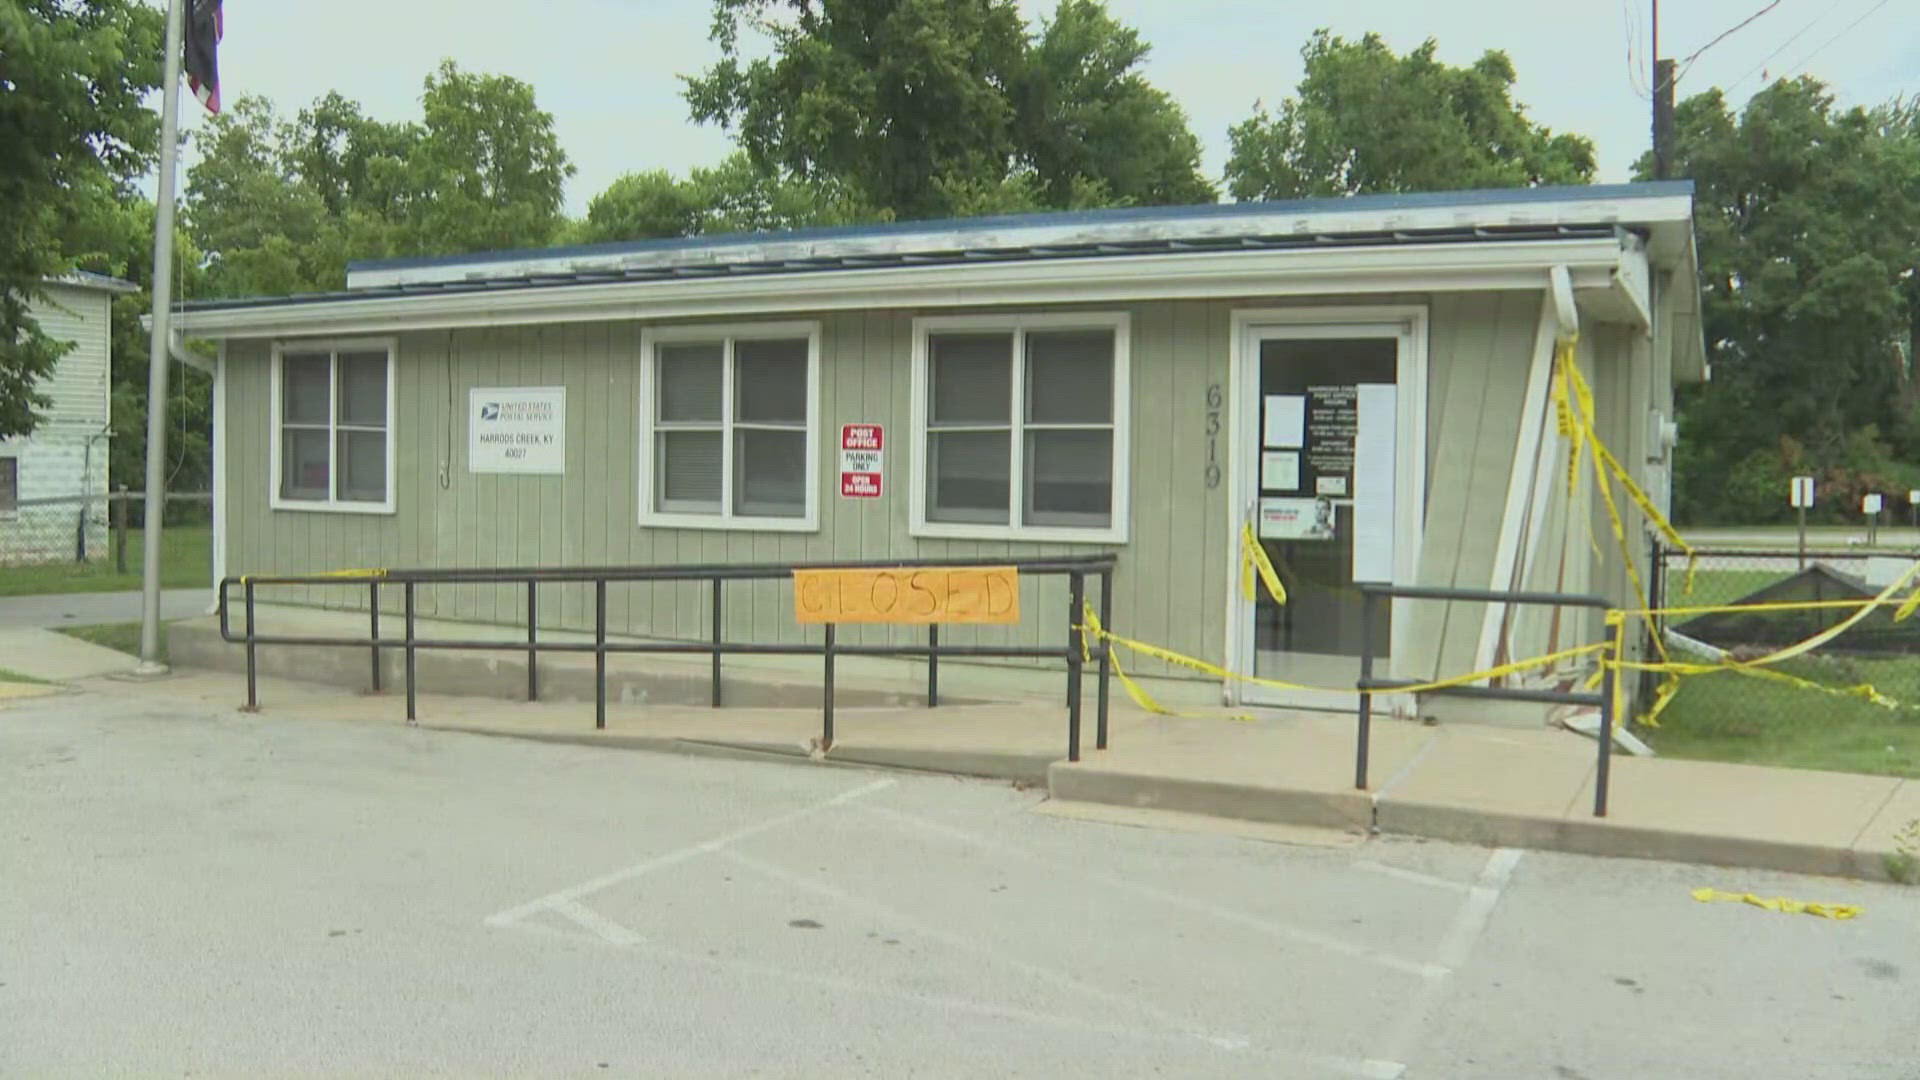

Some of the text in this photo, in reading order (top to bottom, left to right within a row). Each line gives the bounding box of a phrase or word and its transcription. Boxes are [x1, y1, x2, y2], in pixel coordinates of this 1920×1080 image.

[850, 428, 874, 437] POST
[480, 432, 553, 446] HARRODS CREEK, KY
[846, 438, 879, 448] OFFICE
[505, 448, 527, 459] 40027
[846, 452, 878, 462] PARKING
[852, 462, 870, 471] ONLY
[802, 571, 1013, 616] CLOSED
